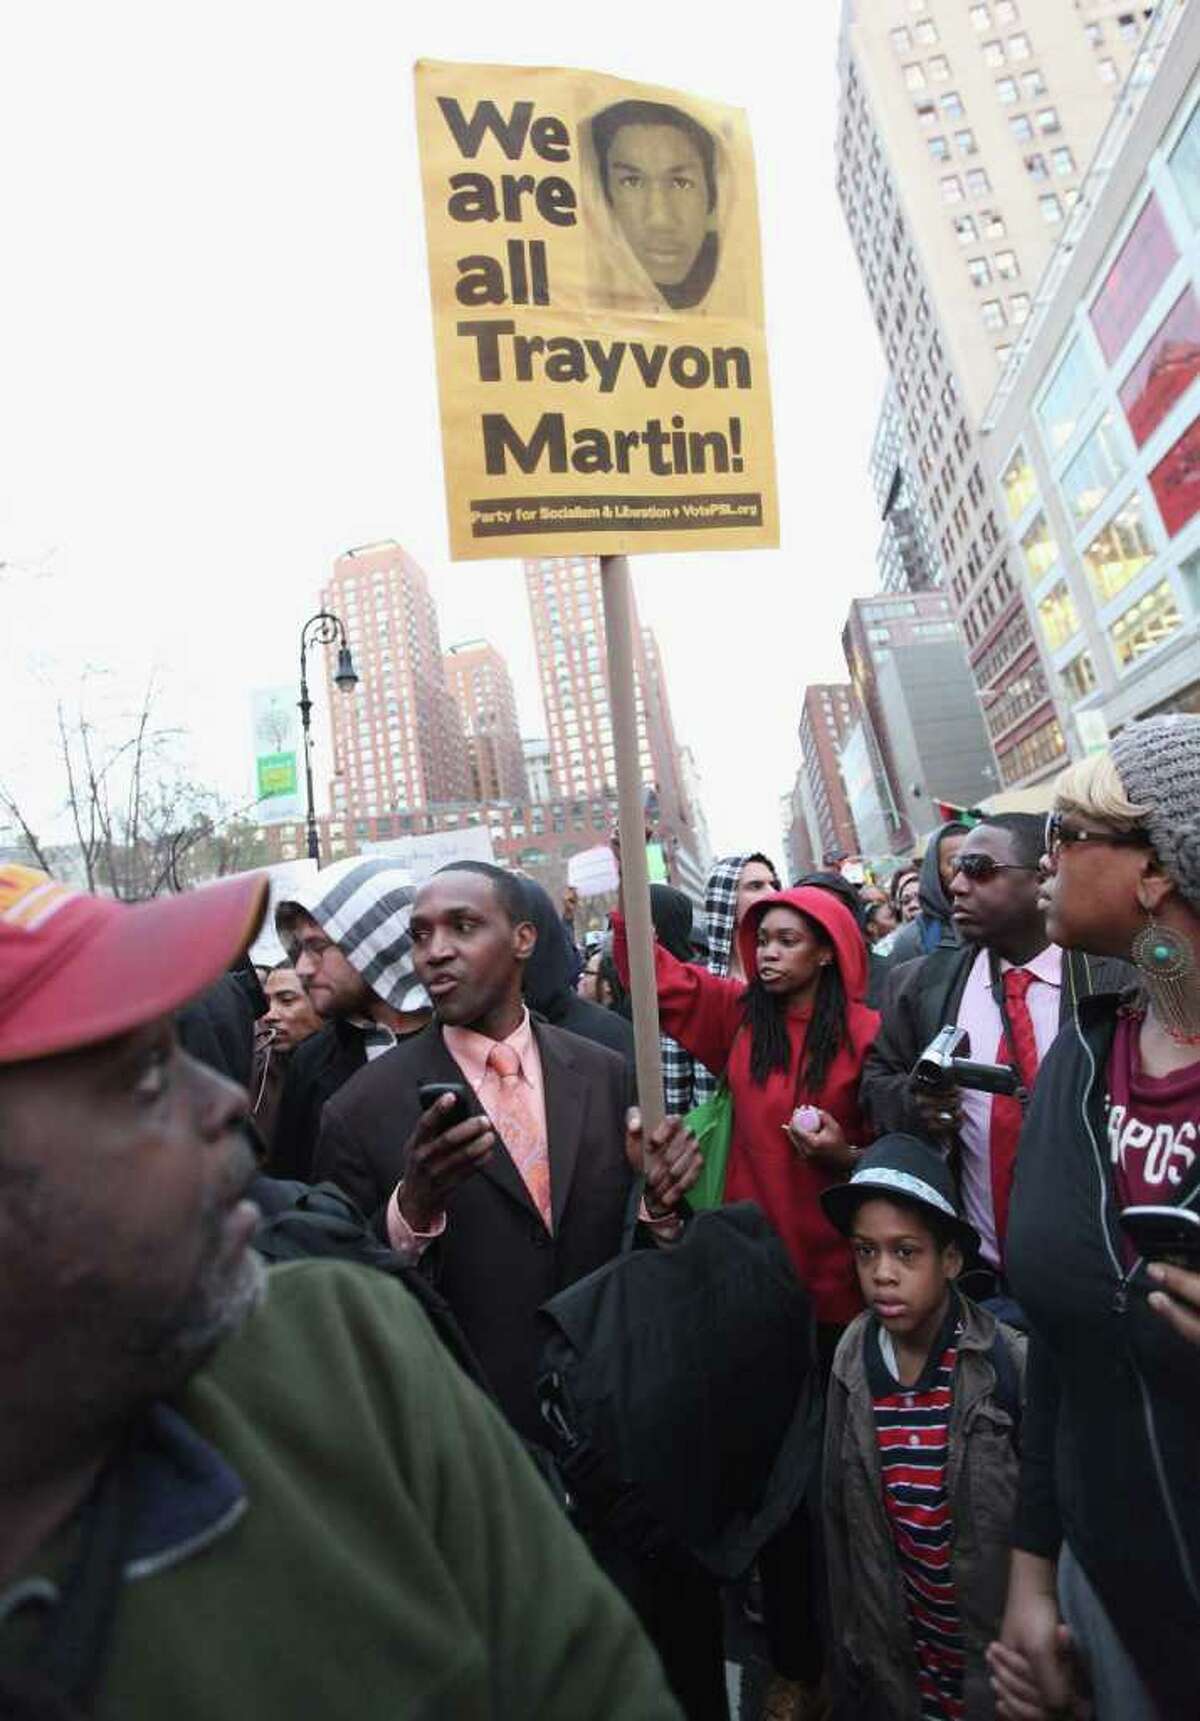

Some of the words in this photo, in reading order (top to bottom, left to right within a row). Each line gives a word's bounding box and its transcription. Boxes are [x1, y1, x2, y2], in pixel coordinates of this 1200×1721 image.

[437, 97, 571, 162] We
[447, 170, 577, 227] are
[455, 240, 550, 307] all
[457, 320, 752, 393] Trayvon
[482, 413, 745, 476] Martin!
[470, 510, 512, 523] Party
[515, 507, 537, 521] for
[540, 505, 600, 519] Socialism
[602, 504, 614, 518] &
[615, 504, 671, 518] Liberation
[682, 503, 757, 518] VotePSL.org
